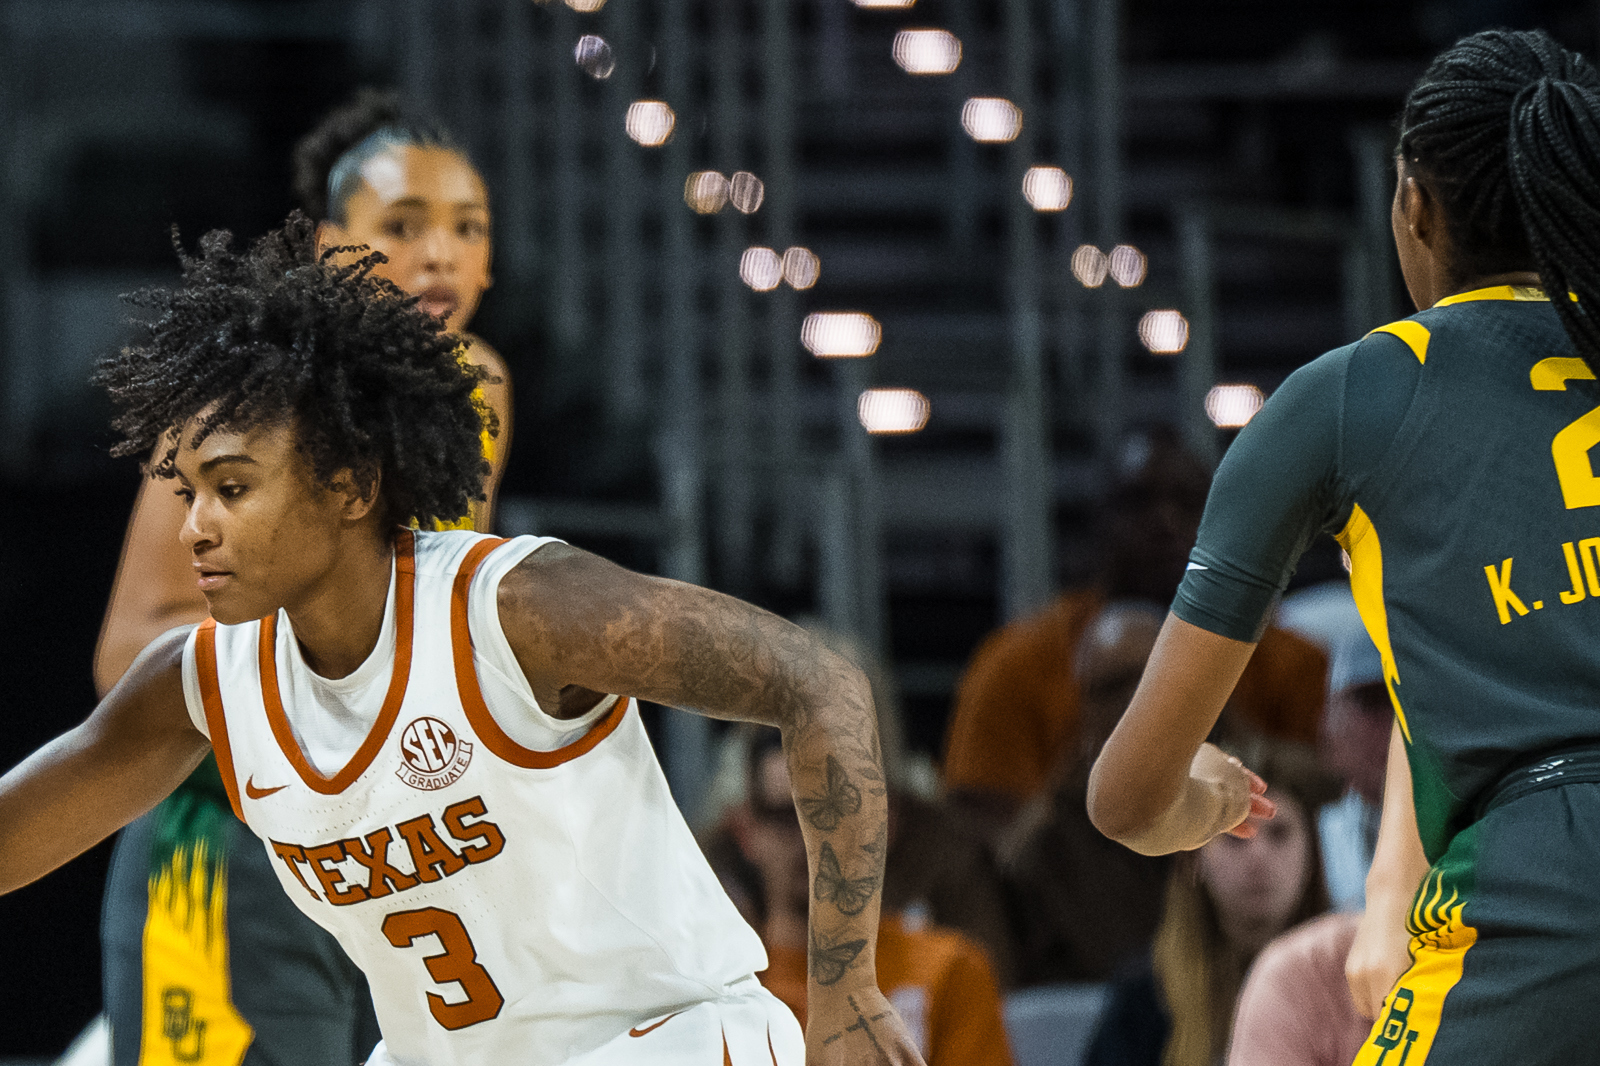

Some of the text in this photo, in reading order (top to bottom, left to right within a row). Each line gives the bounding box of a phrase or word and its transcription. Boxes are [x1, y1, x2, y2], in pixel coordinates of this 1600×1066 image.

[1484, 557, 1544, 625] K.
[402, 717, 457, 773] SEC
[408, 756, 469, 790] GRADUATE
[268, 795, 506, 906] TEXAS
[381, 906, 505, 1031] 3
